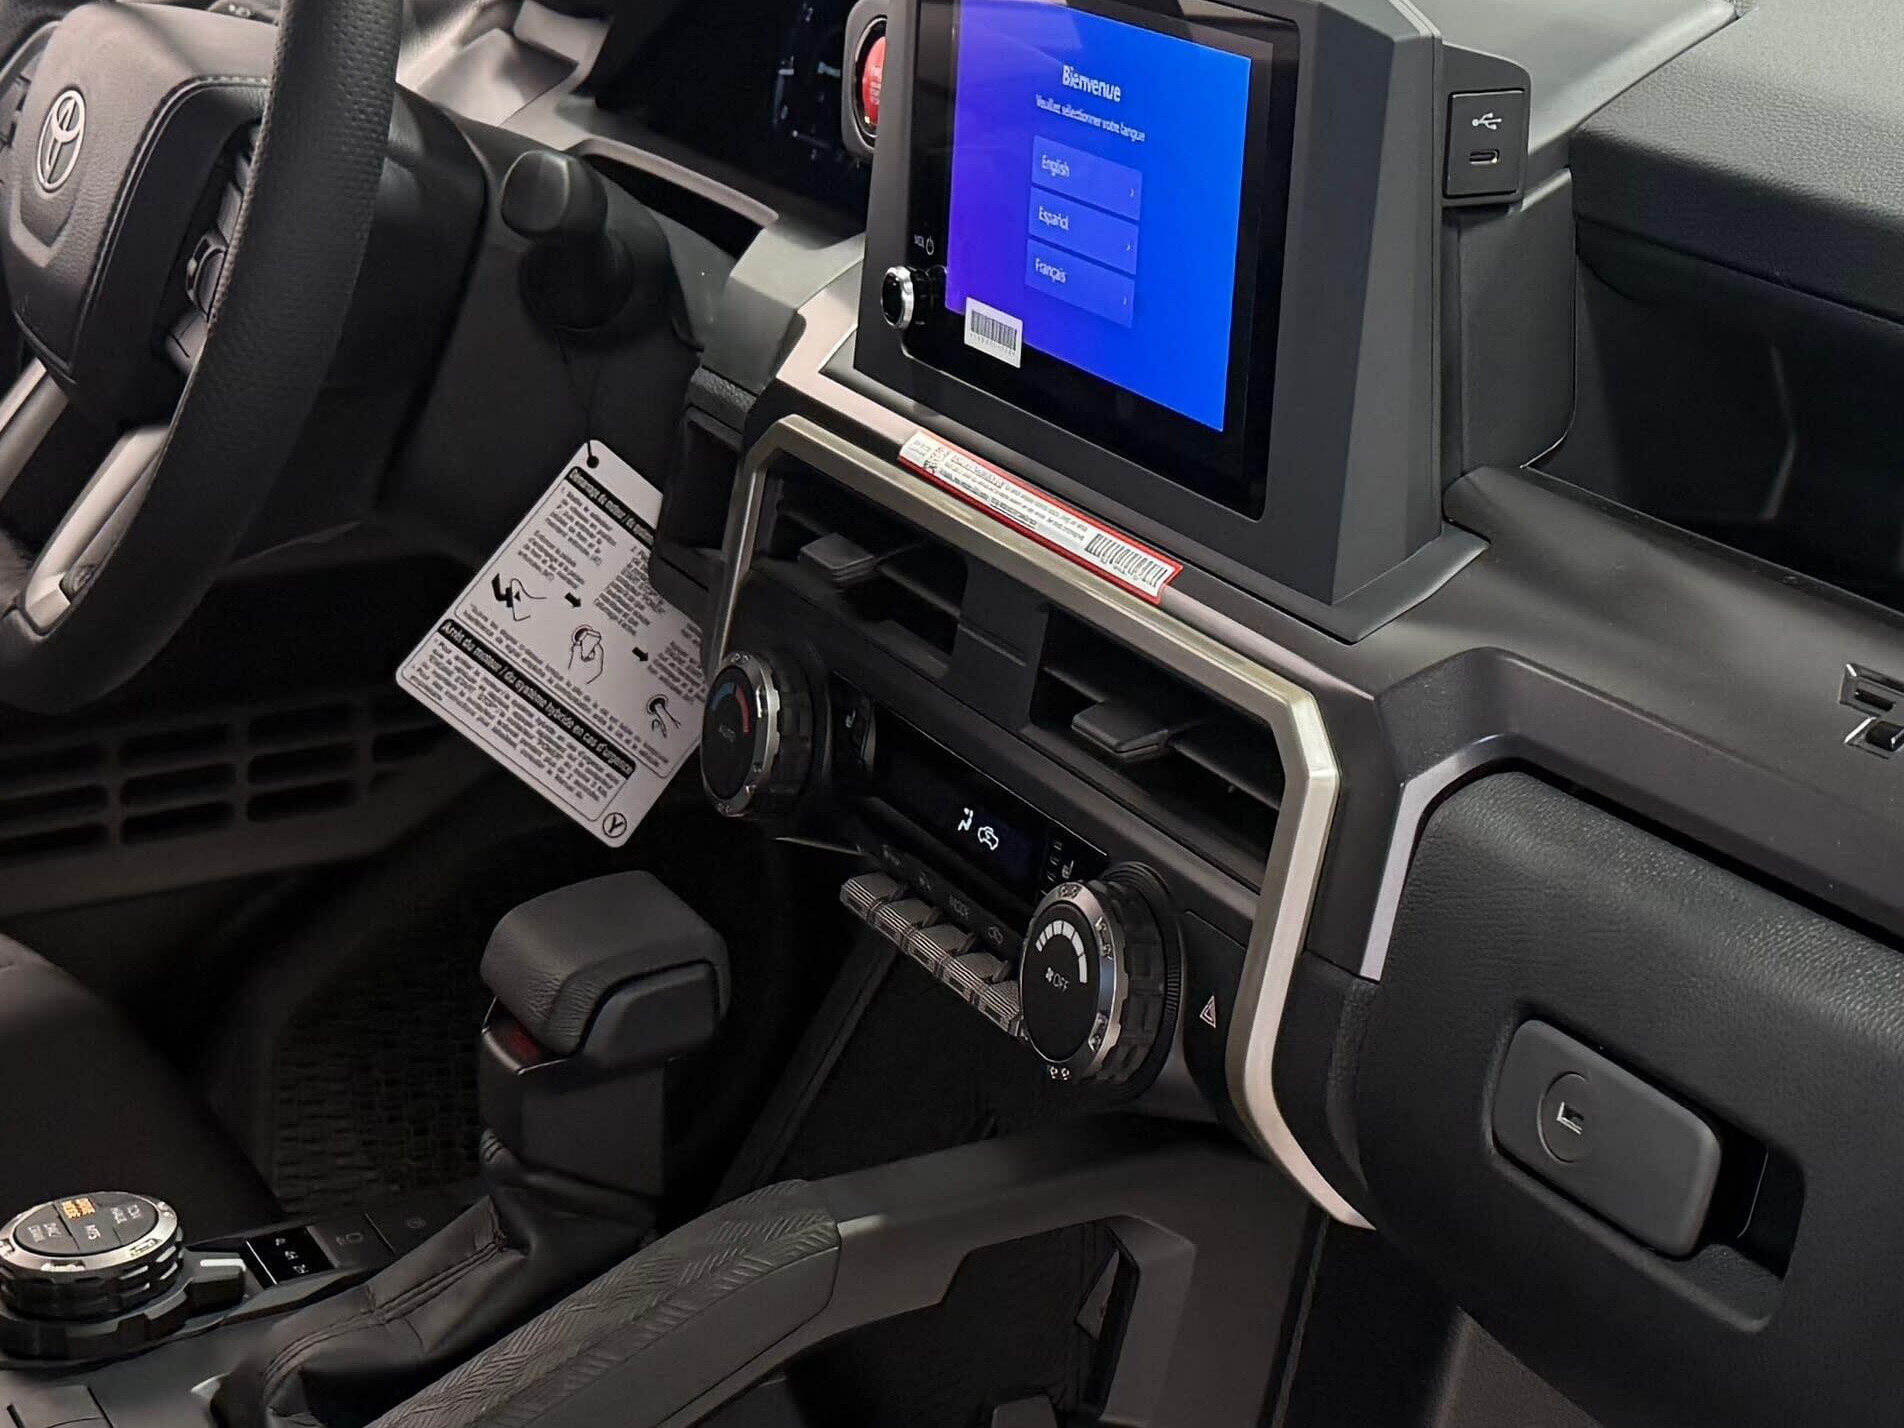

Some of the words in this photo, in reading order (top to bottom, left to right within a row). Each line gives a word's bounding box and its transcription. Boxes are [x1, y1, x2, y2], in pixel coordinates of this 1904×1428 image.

[1062, 64, 1121, 102] Bienvenue
[1041, 154, 1071, 178] English
[607, 814, 624, 834] Y
